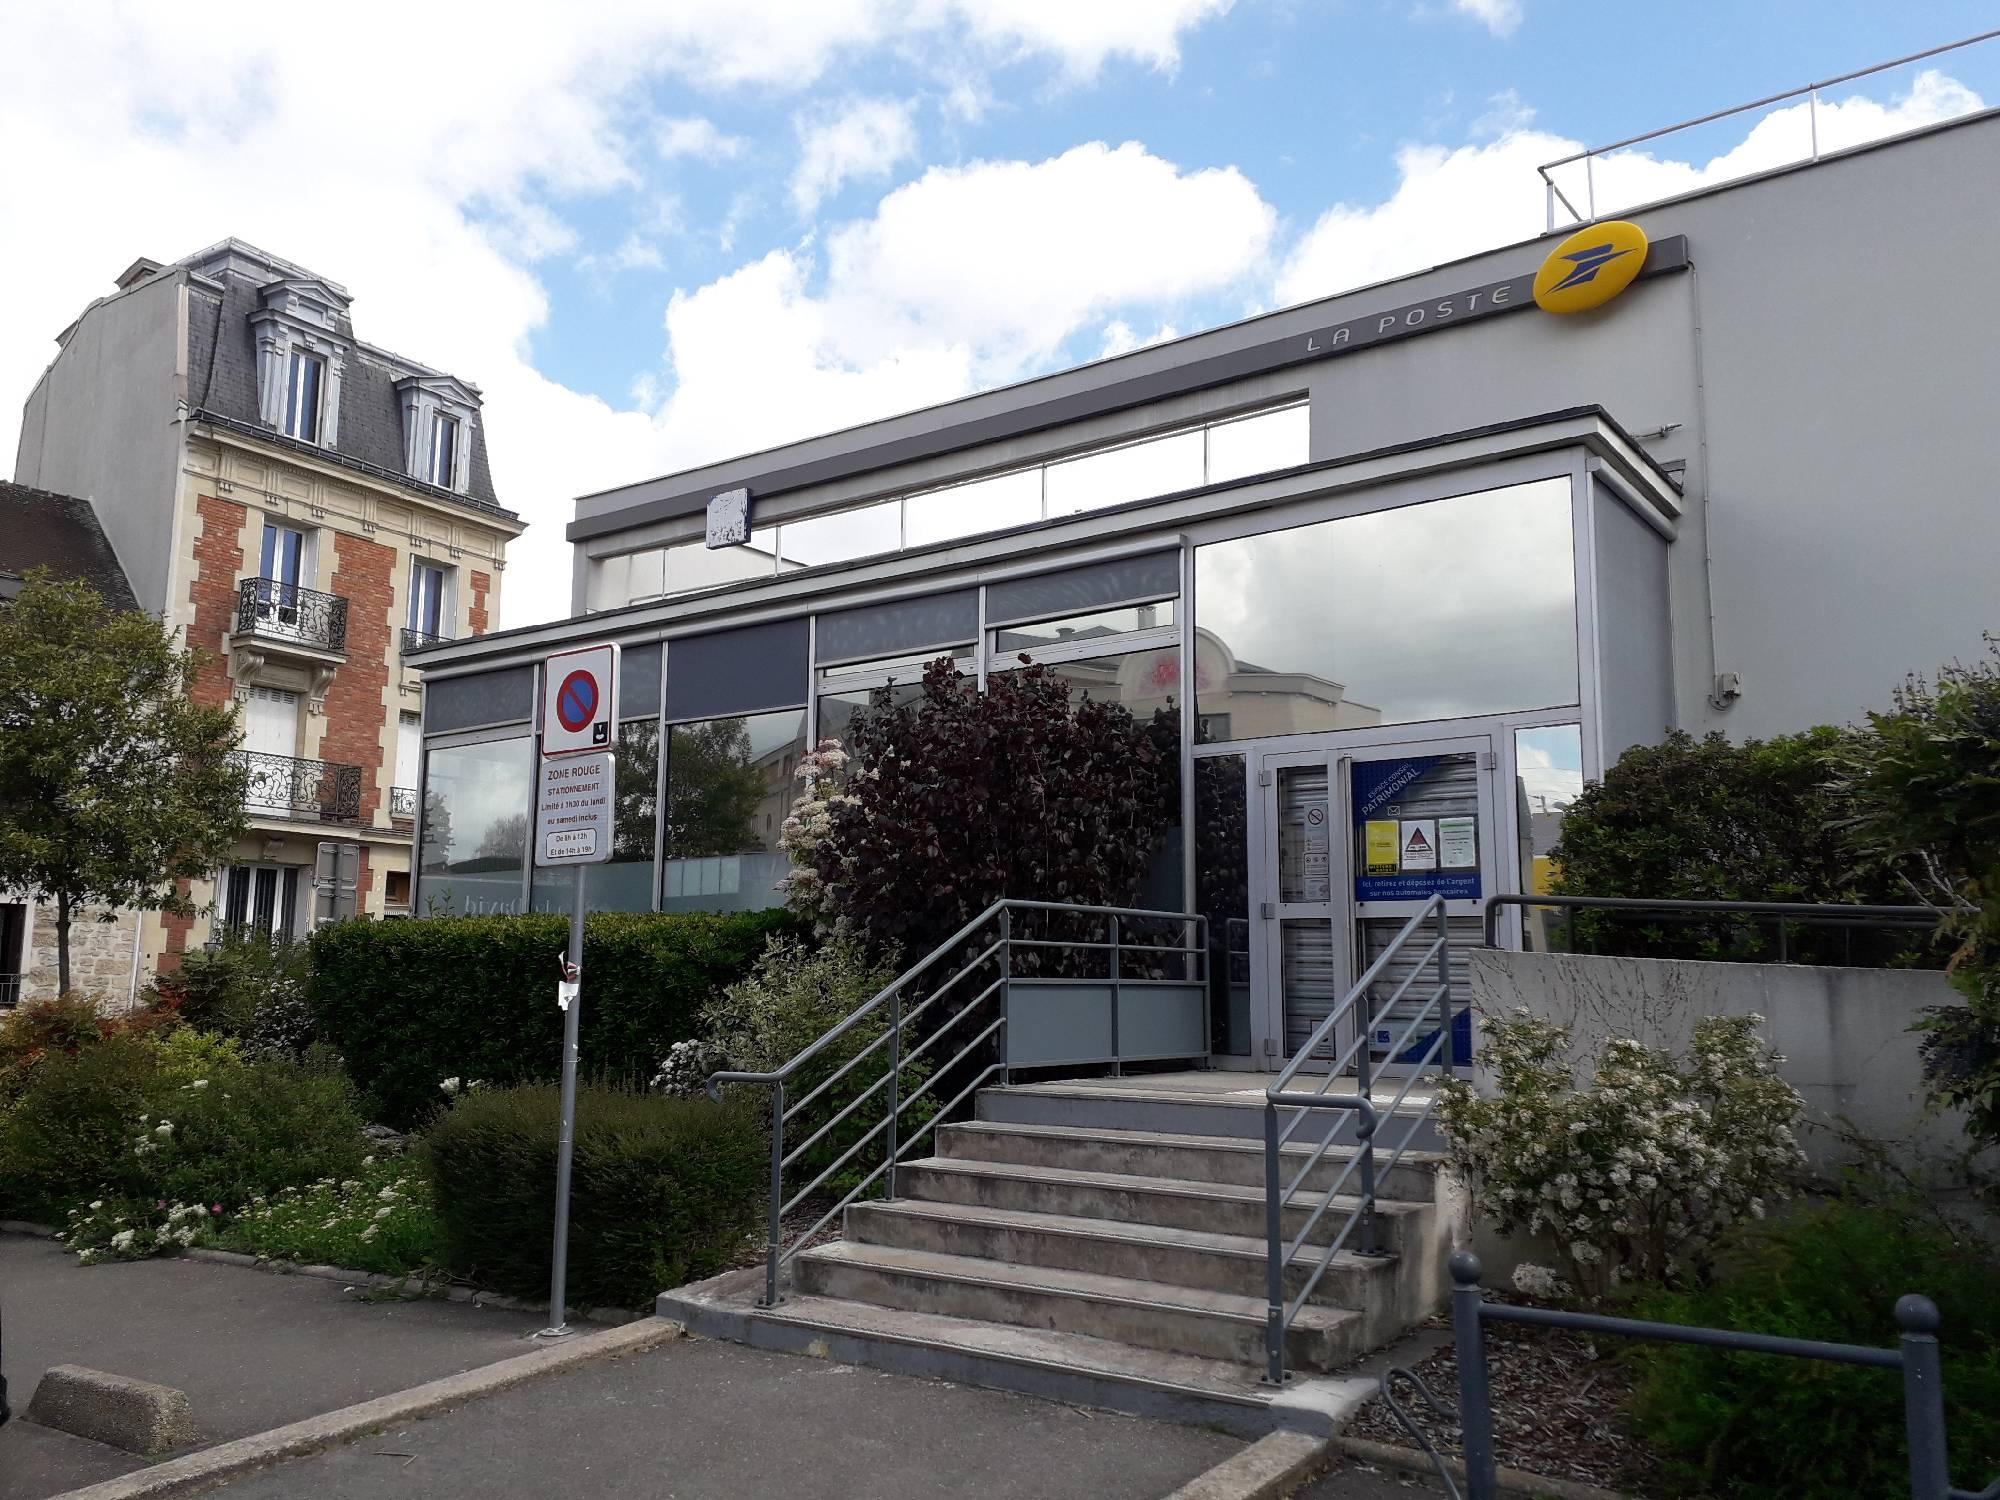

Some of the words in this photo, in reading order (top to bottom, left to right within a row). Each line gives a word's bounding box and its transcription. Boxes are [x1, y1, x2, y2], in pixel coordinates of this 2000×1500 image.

[1307, 328, 1350, 352] LA
[1377, 285, 1512, 334] POSTE
[547, 769, 570, 781] ZONE
[572, 765, 600, 777] ROUGE
[547, 783, 600, 796] STATIONNEMENT
[1361, 768, 1421, 816] PATRIMONIAL
[541, 801, 559, 811] Limité
[557, 815, 577, 824] samedi
[579, 813, 598, 821] inclus
[1406, 879, 1434, 888] déposez
